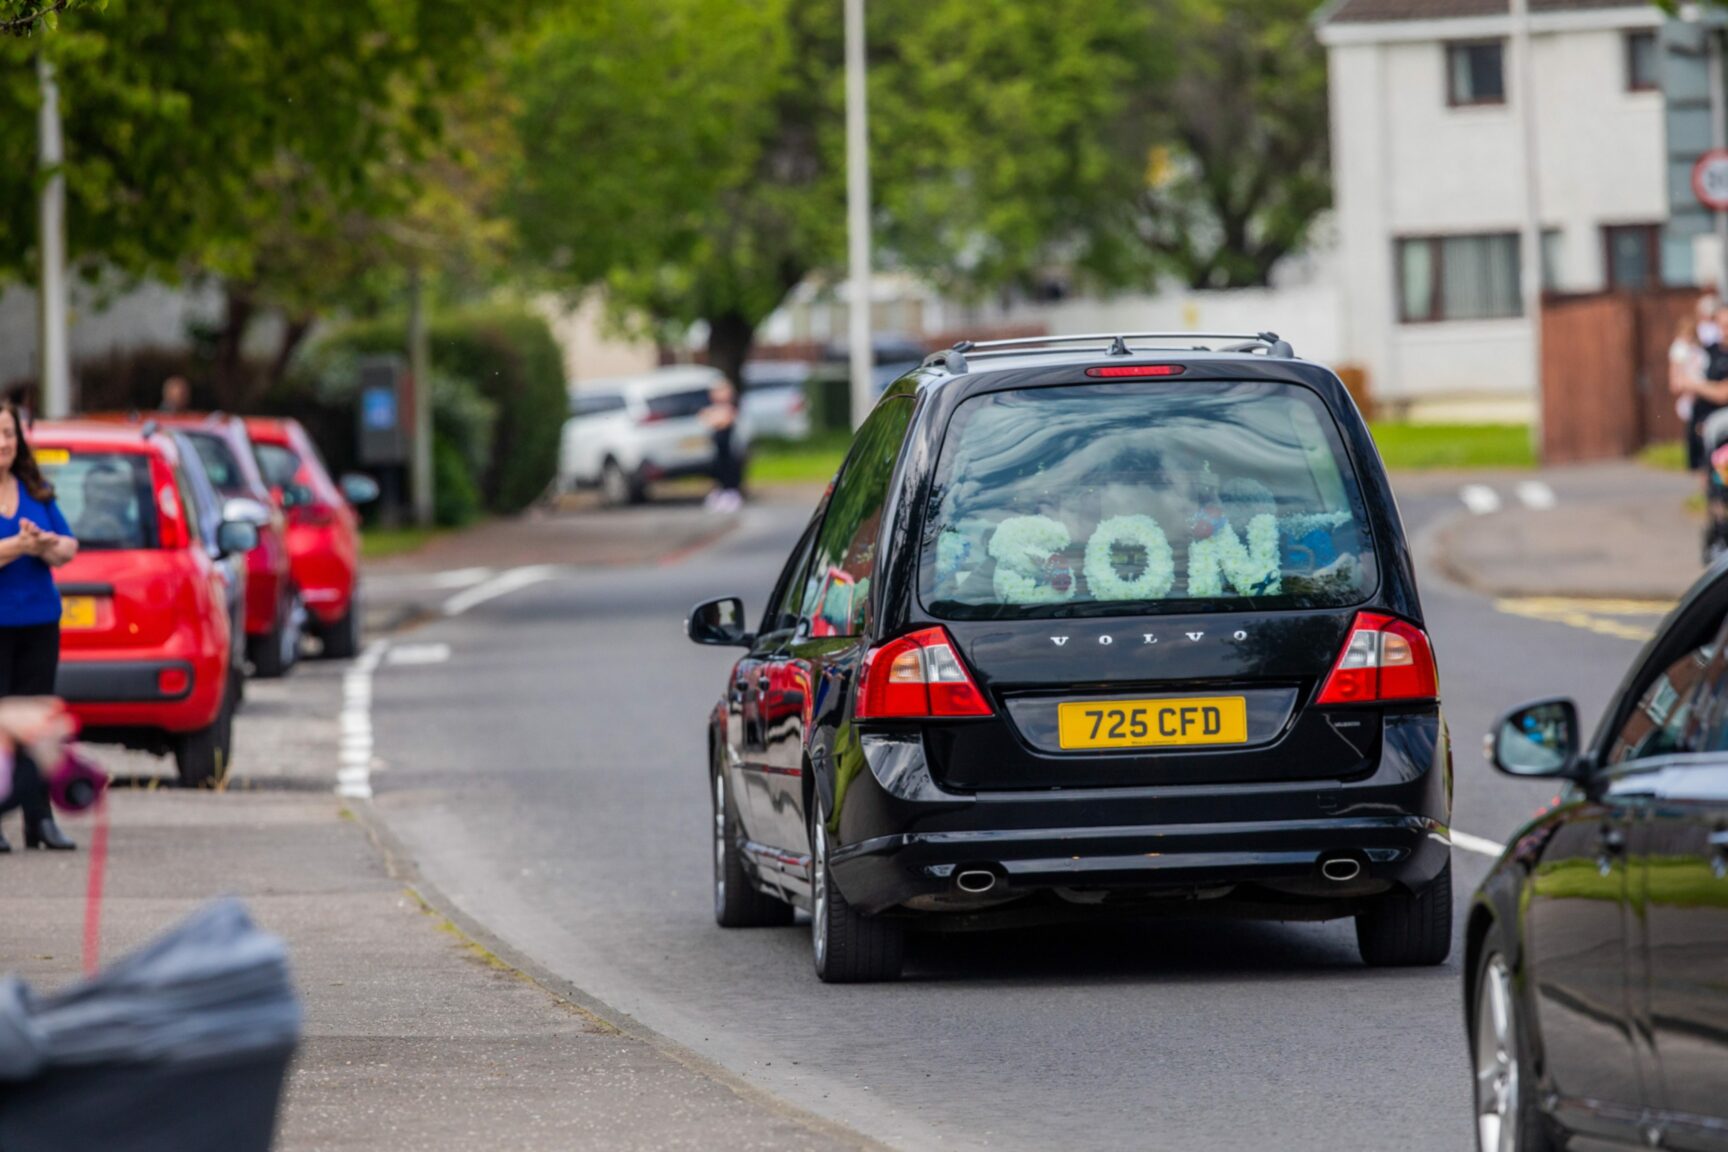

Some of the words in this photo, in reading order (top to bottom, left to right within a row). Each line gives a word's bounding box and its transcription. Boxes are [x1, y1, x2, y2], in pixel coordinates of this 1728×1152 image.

[989, 513, 1281, 603] SON
[1050, 630, 1247, 646] VOLVO
[1085, 709, 1148, 740] 725
[1158, 706, 1221, 737] CFD
